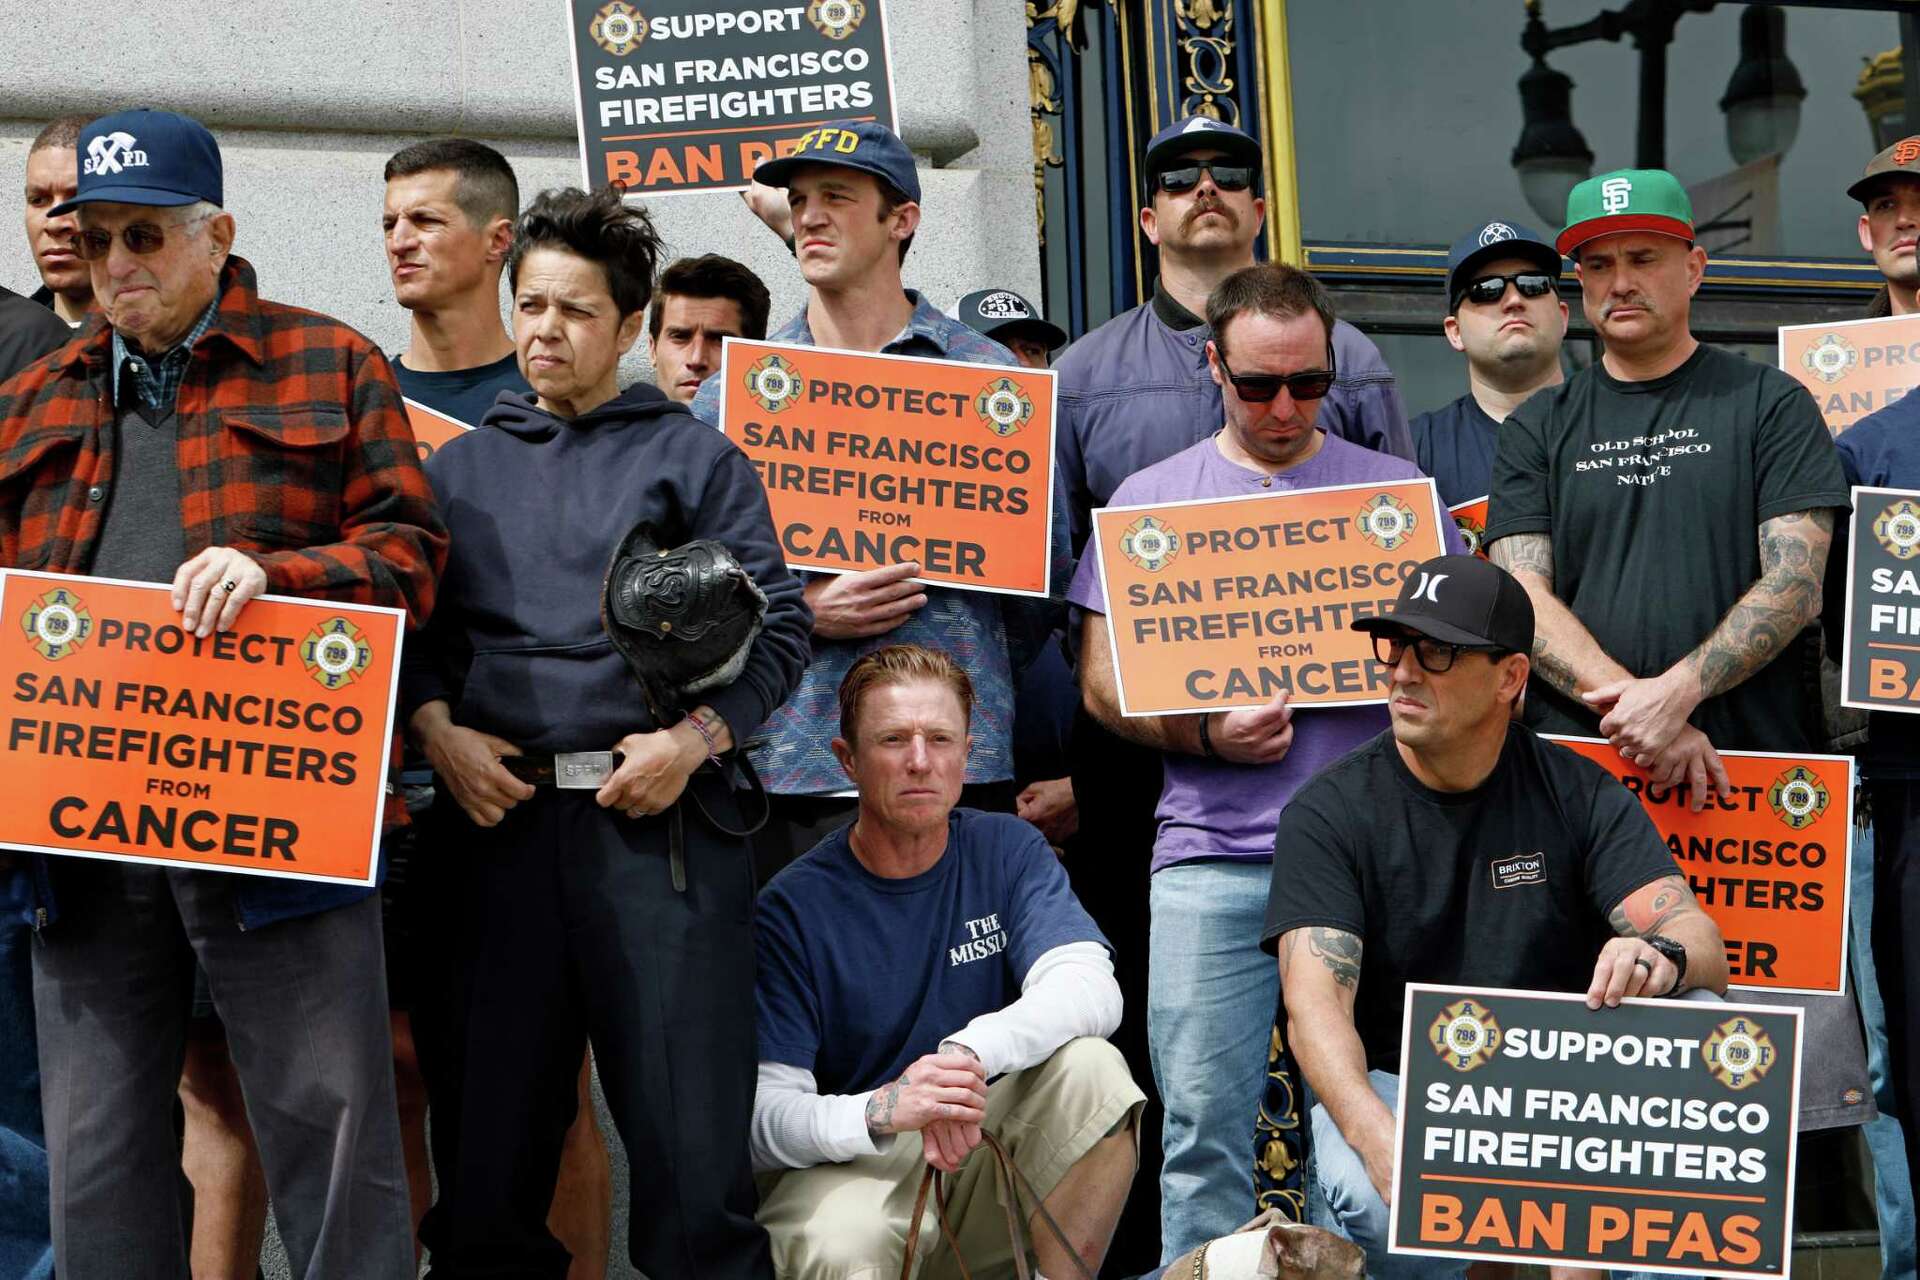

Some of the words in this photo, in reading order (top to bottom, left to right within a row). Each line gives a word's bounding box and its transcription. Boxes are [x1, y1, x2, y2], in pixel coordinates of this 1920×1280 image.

[650, 7, 804, 40] SUPPORT
[828, 7, 845, 18] 798
[610, 22, 628, 33] 798
[596, 63, 665, 90] SAN
[675, 48, 868, 84] FRANCISCO
[600, 81, 873, 127] FIREFIGHTERS
[792, 128, 859, 154] FFD
[607, 145, 723, 188] BAN
[766, 378, 784, 388] 798
[809, 380, 969, 417] PROTECT
[996, 401, 1014, 412] 798
[1813, 391, 1872, 414] AN
[744, 423, 814, 452] SAN
[827, 432, 1030, 474] FRANCISCO
[1591, 441, 1629, 453] OLD
[1576, 458, 1613, 471] SAN
[859, 510, 910, 526] FROM
[1378, 517, 1396, 527] 798
[1187, 518, 1350, 554] PROTECT
[1896, 525, 1915, 535] 798
[783, 523, 985, 576] CANCER
[1142, 539, 1161, 550] 798
[1128, 581, 1201, 606] SAN
[48, 618, 68, 631] 798
[326, 647, 347, 660] 798
[1259, 644, 1312, 657] FROM
[15, 673, 100, 708] SAN
[116, 683, 362, 735] FRANCISCO
[10, 719, 356, 785] FIREFIGHTERS
[147, 779, 210, 799] FROM
[1790, 792, 1808, 803] 798
[50, 797, 298, 860] CANCER
[1498, 860, 1540, 875] BRIXTON
[965, 914, 1001, 939] THE
[1456, 1029, 1477, 1042] 798
[1503, 1028, 1699, 1068] SUPPORT
[1729, 1047, 1750, 1060] 798
[1425, 1083, 1512, 1117] SAN
[1525, 1089, 1769, 1133] FRANCISCO
[1424, 1127, 1766, 1183] FIREFIGHTERS
[1421, 1194, 1565, 1250] BAN
[1589, 1206, 1760, 1264] PFAS
